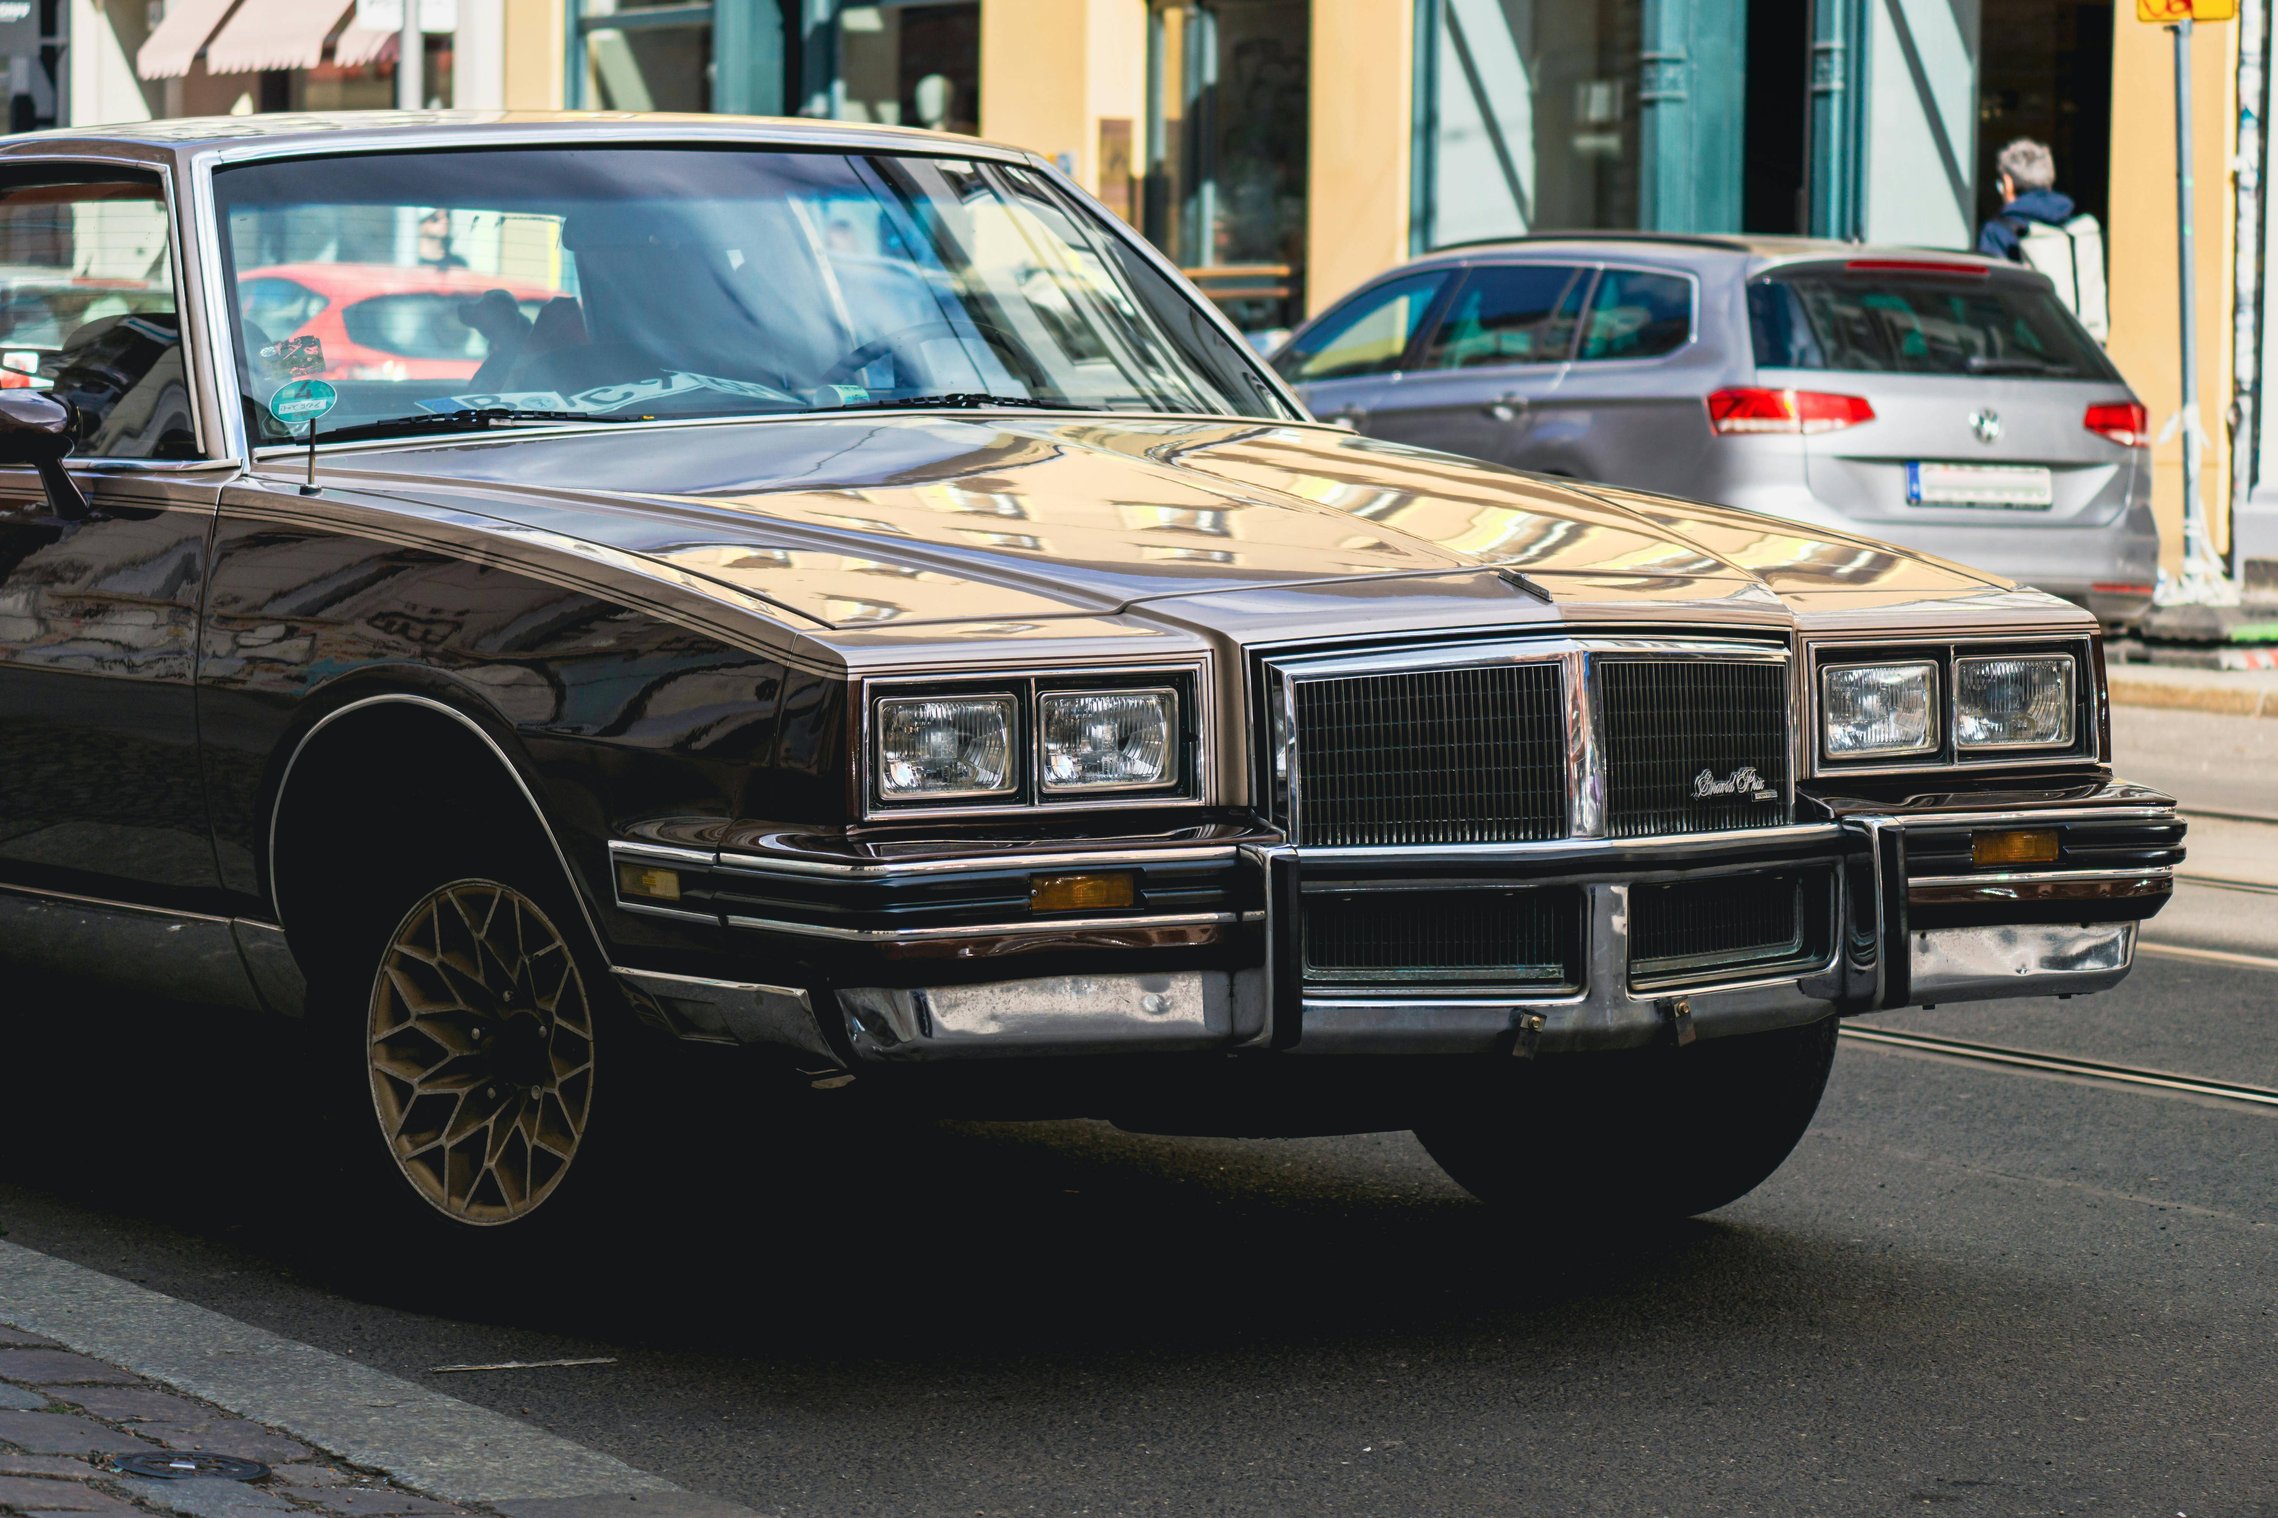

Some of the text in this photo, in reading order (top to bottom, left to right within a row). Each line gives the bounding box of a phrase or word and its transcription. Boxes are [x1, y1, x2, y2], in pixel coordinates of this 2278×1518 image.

[295, 381, 312, 399] 4
[1692, 767, 1766, 799] Grand Prix
